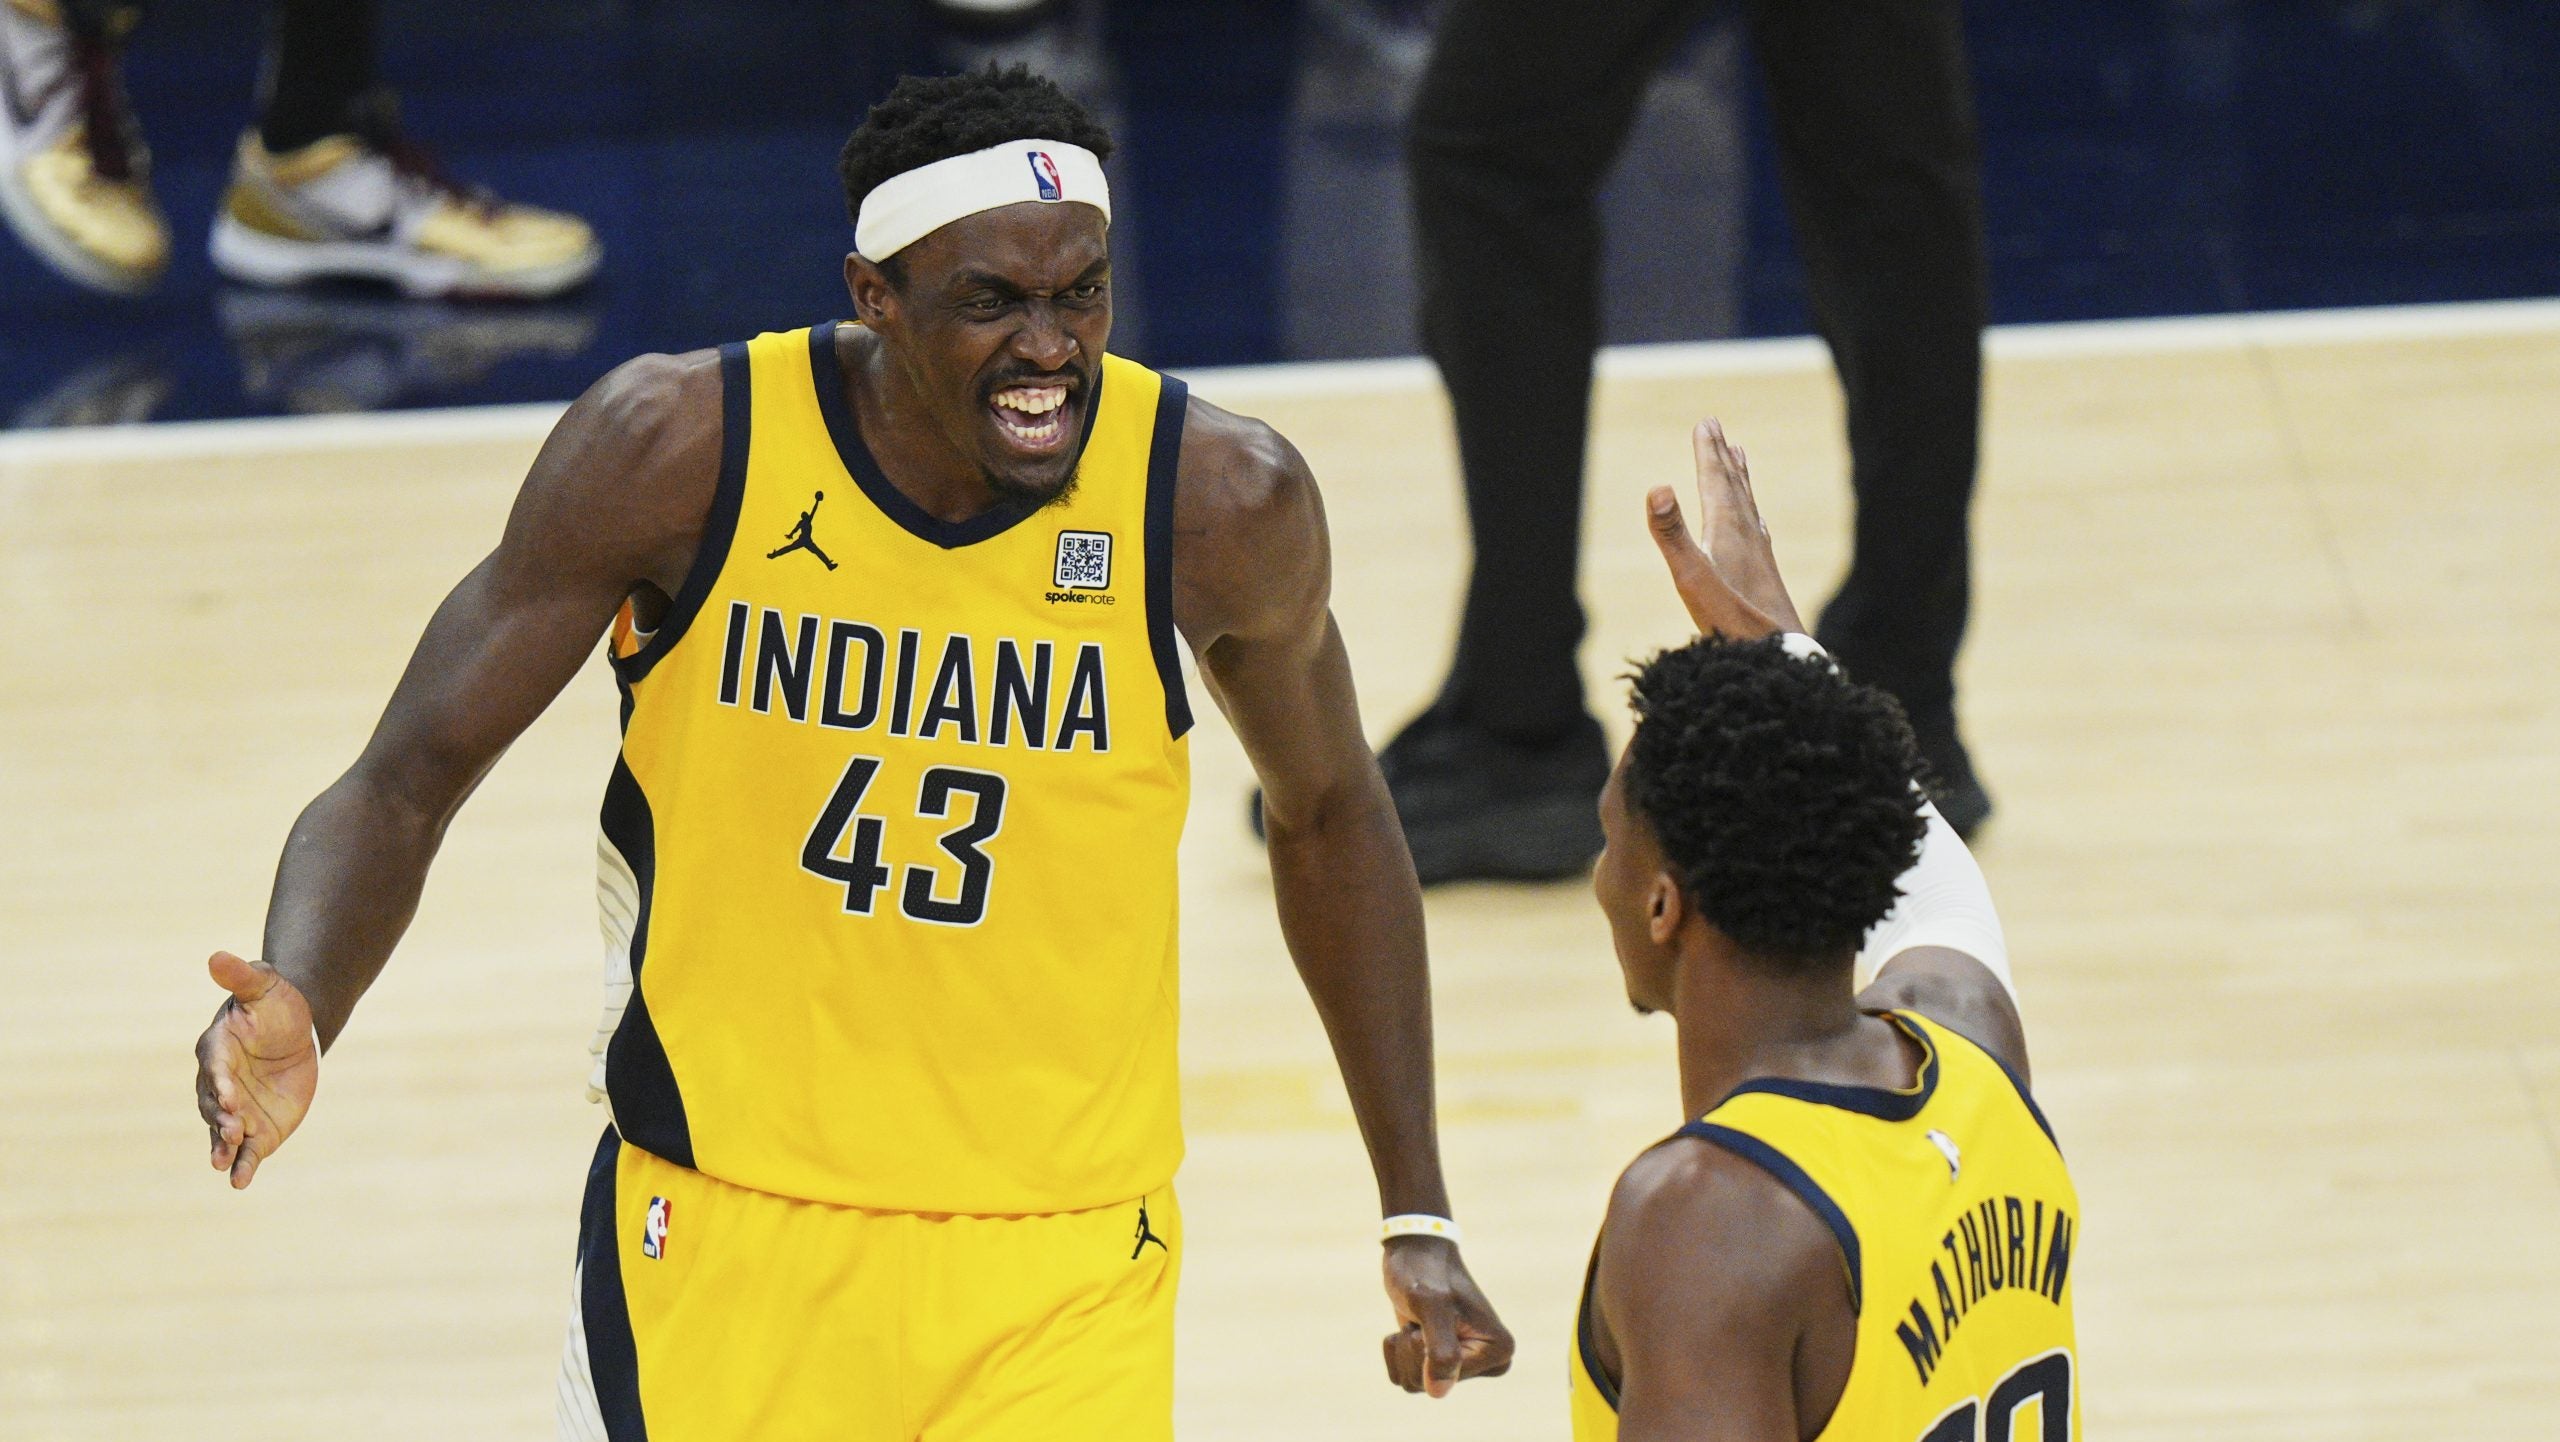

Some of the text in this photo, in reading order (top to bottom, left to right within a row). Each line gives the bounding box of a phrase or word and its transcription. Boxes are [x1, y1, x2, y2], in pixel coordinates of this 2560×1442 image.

[717, 601, 1111, 752] INDIANA
[1045, 590, 1116, 605] spokenote
[801, 754, 1009, 928] 43
[1895, 1195, 2072, 1387] MATHURIN
